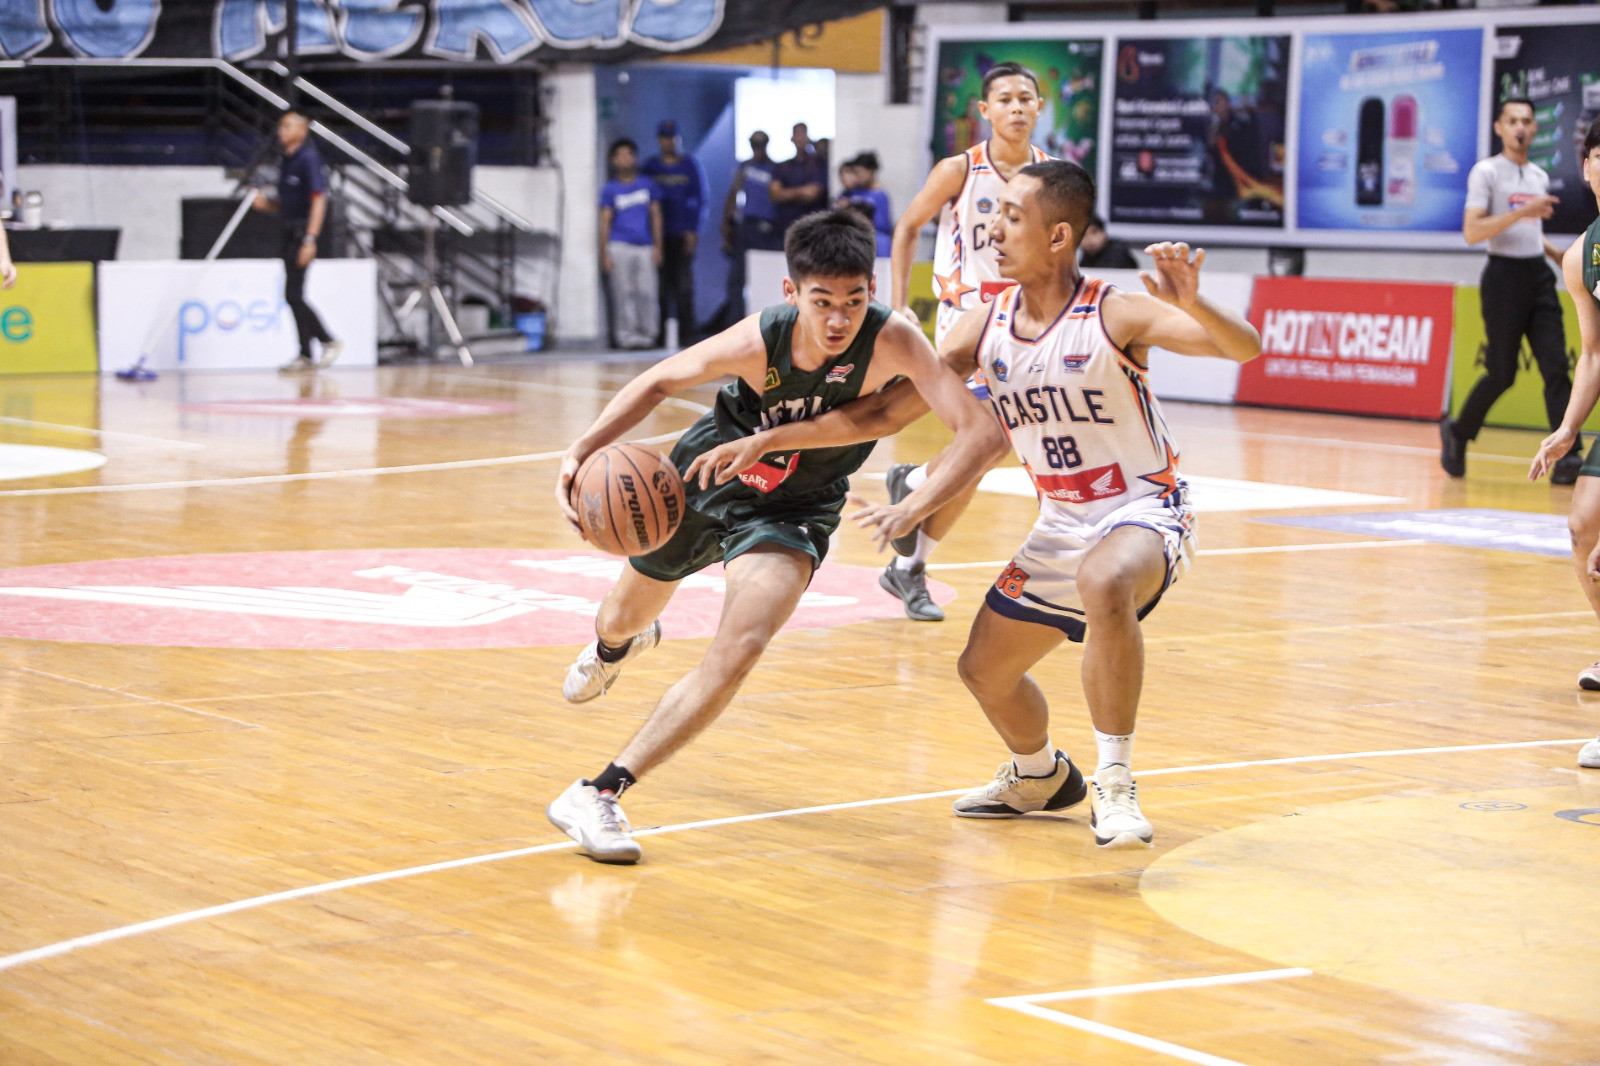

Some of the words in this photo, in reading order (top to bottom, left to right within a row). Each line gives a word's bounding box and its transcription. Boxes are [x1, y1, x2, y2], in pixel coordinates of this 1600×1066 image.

[999, 385, 1114, 430] CASTLE
[1042, 436, 1082, 469] 88
[619, 474, 651, 550] proteam
[663, 493, 680, 535] DBL
